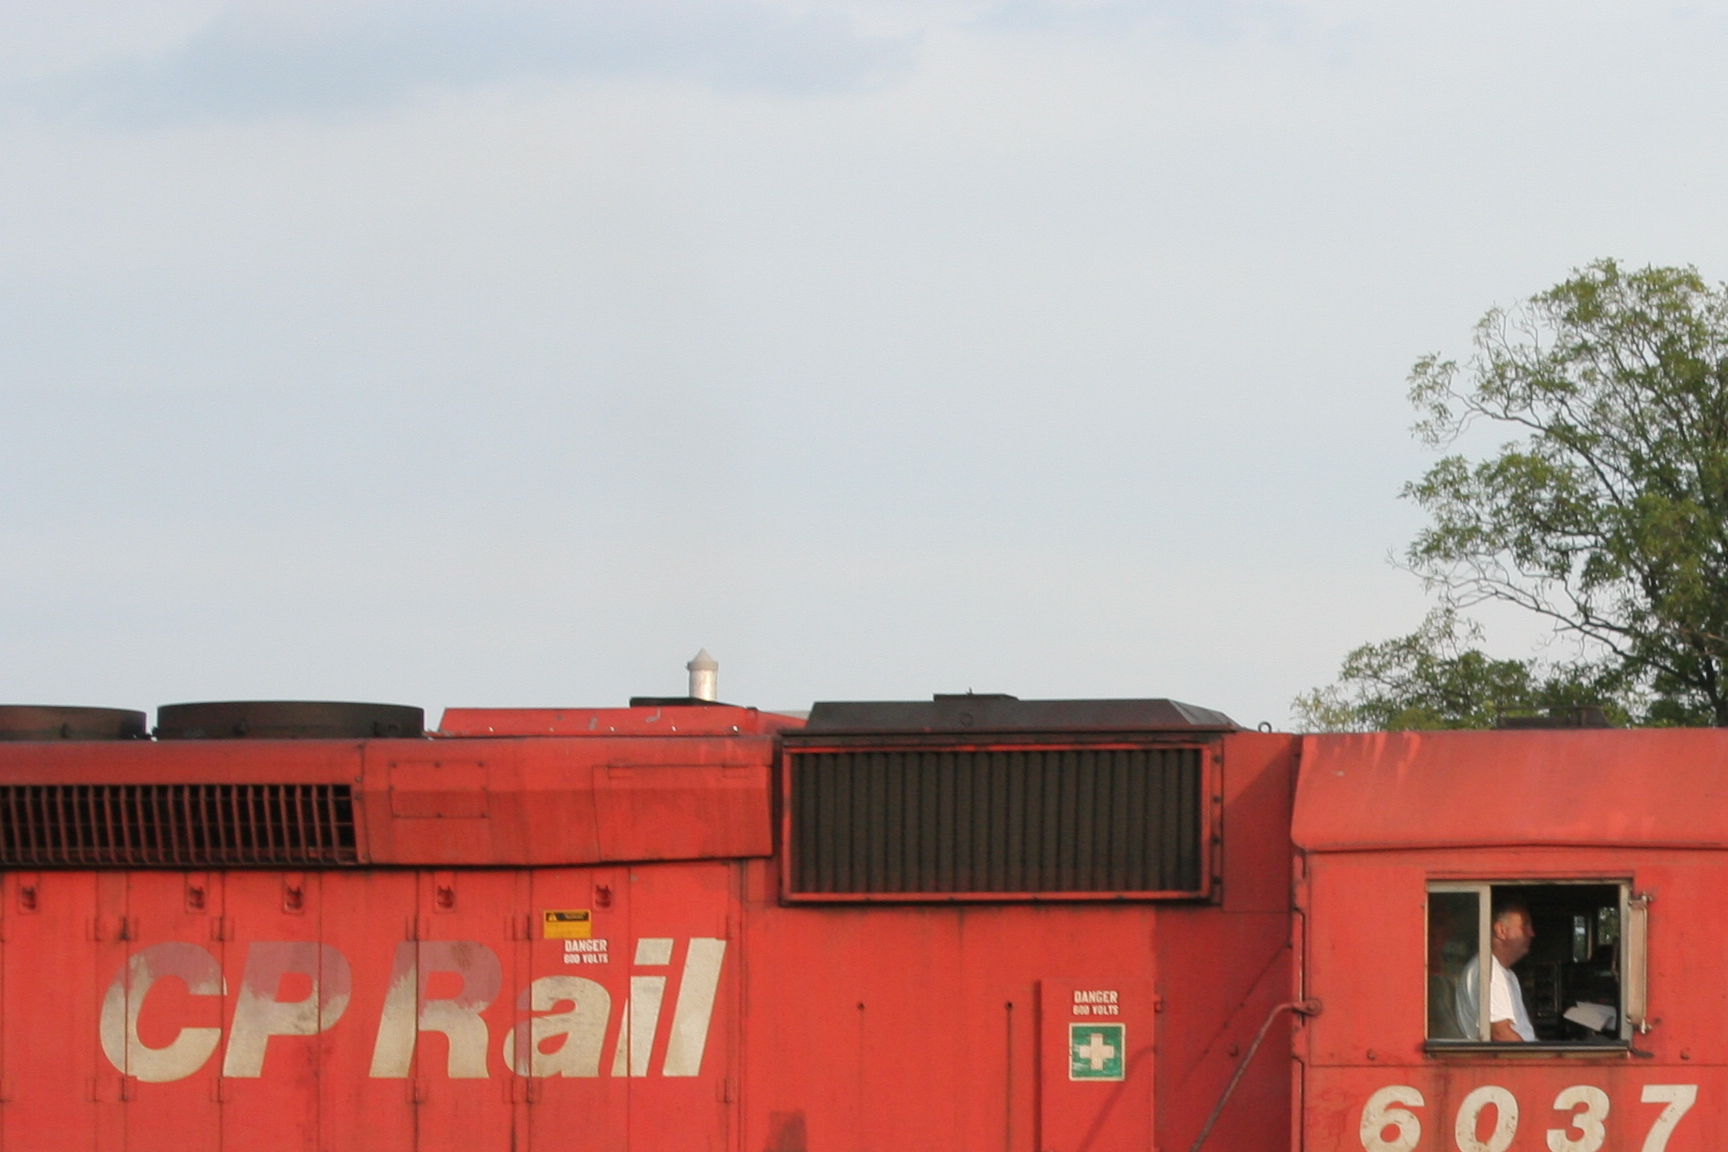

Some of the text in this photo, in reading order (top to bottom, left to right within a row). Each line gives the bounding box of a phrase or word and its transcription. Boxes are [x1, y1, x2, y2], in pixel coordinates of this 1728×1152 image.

[564, 939, 608, 952] DANGER
[582, 953, 609, 964] VOLTS
[1074, 991, 1118, 1003] DANGER
[100, 937, 727, 1083] CP Rail
[1092, 1005, 1119, 1015] VOLTS
